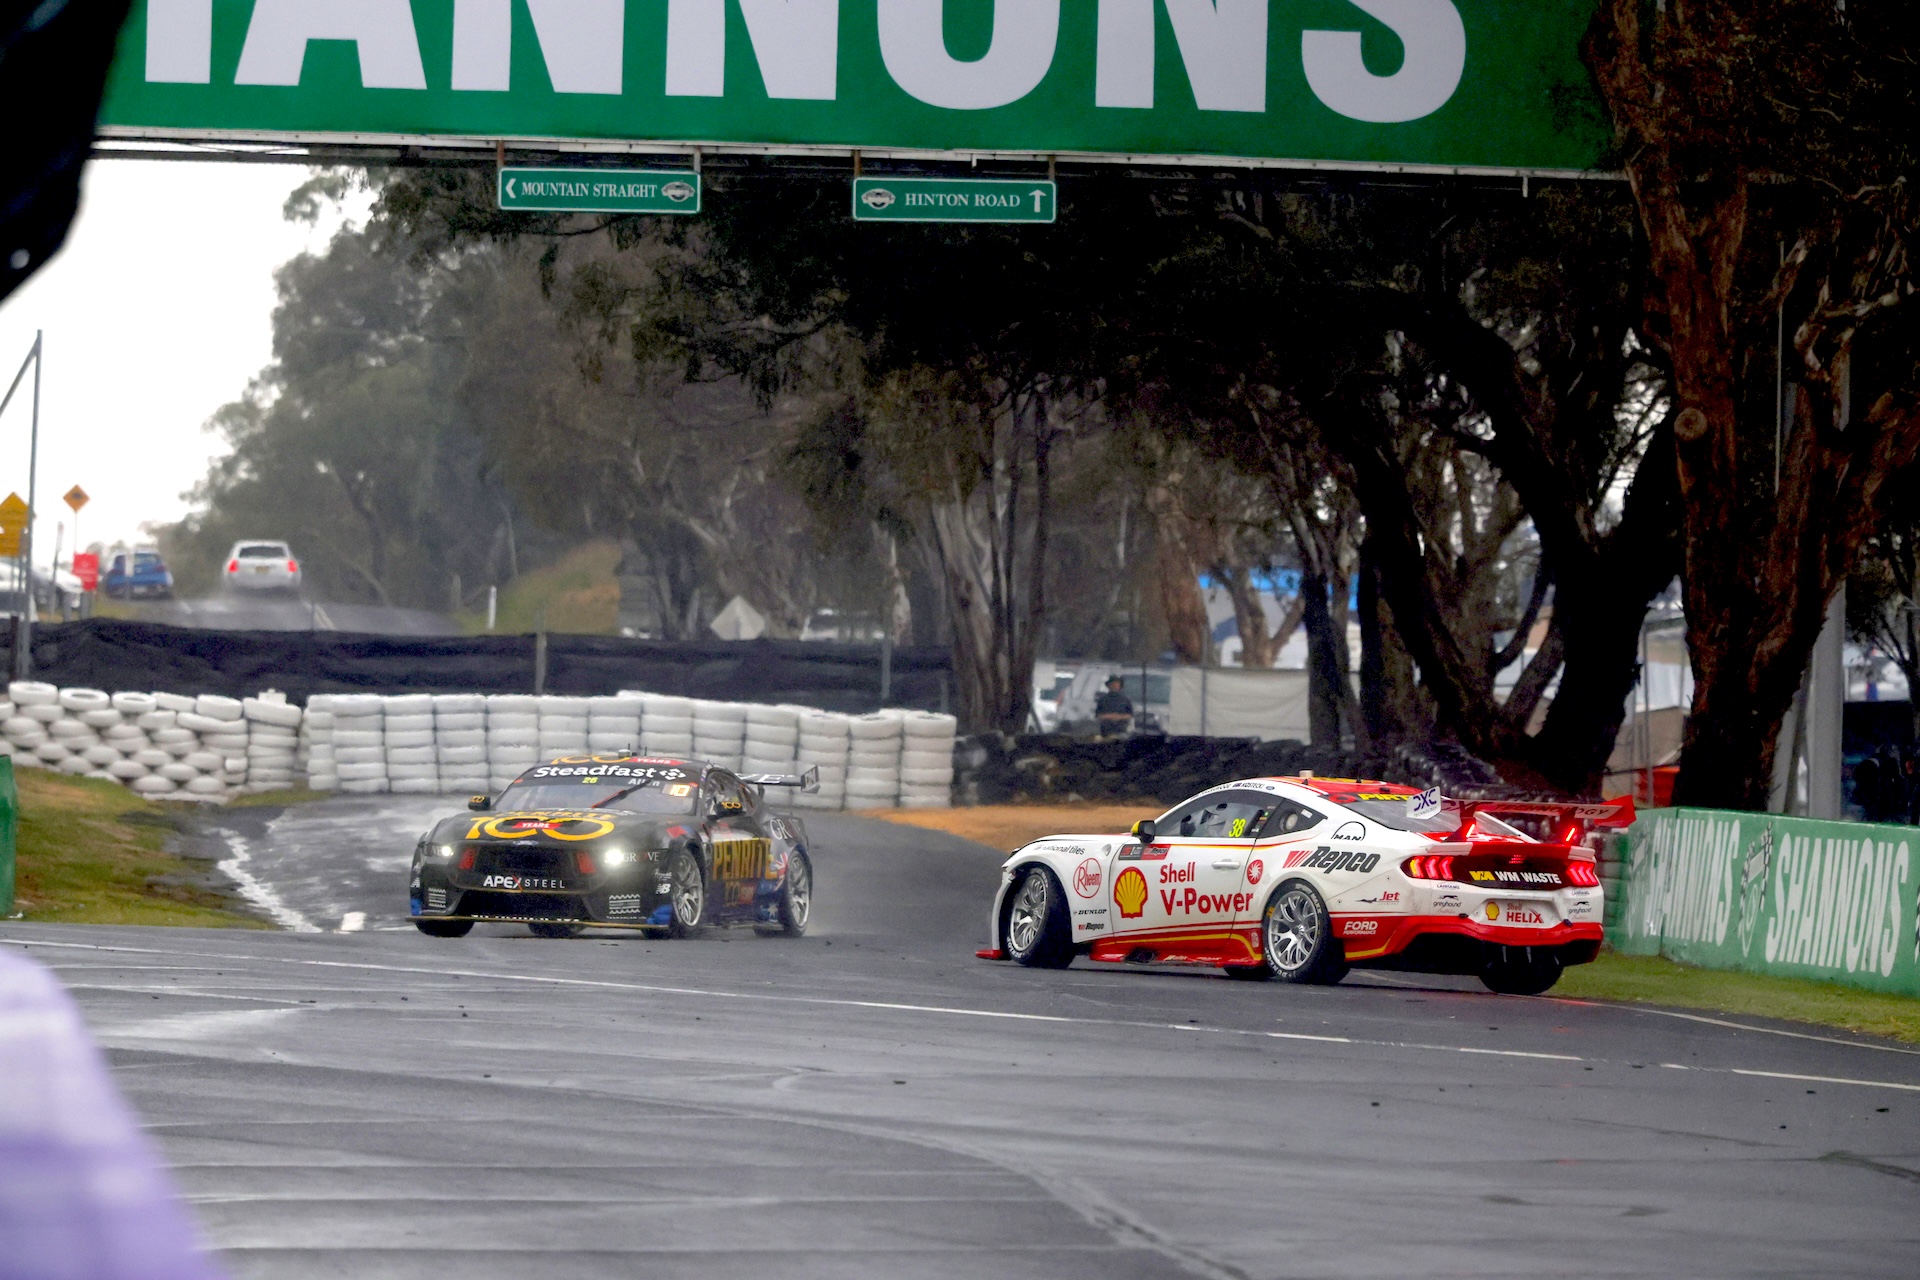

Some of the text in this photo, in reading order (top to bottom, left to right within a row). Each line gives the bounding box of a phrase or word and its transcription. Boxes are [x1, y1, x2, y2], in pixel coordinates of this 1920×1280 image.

[521, 182, 658, 198] MOUNTAIN STRAIGHT
[905, 193, 1021, 207] HINTON ROAD
[533, 764, 657, 778] Steadfast
[668, 784, 692, 797] 10
[1413, 788, 1437, 812] DXC
[521, 821, 551, 829] YEARS
[1228, 818, 1246, 838] 38
[1300, 846, 1381, 874] Repco
[1077, 866, 1101, 892] Rheem
[1160, 862, 1196, 884] Shell
[1495, 871, 1562, 884] WM WASTE
[483, 875, 565, 892] APEX STEEL
[1160, 887, 1254, 916] V-Power
[1379, 891, 1400, 901] Jet
[1078, 908, 1107, 916] DUNLOP
[1506, 902, 1523, 911] Shell
[1765, 832, 1909, 978] SHANNONS
[1506, 910, 1545, 924] HELIX
[1344, 921, 1378, 930] FORD
